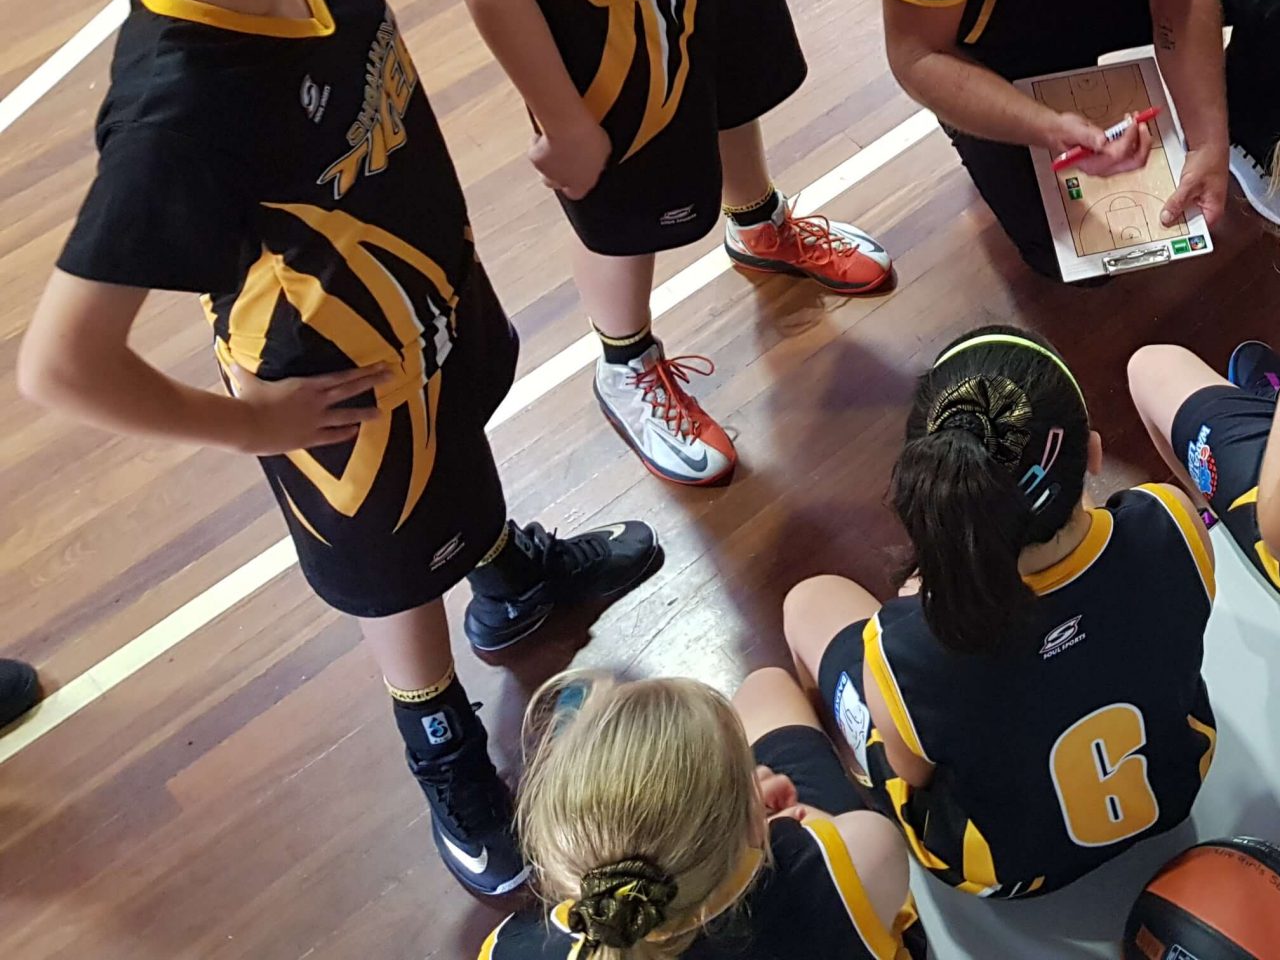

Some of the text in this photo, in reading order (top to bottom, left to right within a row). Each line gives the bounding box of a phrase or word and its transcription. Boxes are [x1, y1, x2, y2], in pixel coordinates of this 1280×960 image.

[1043, 633, 1086, 660] SOUL SPORTS
[1049, 702, 1160, 848] 6
